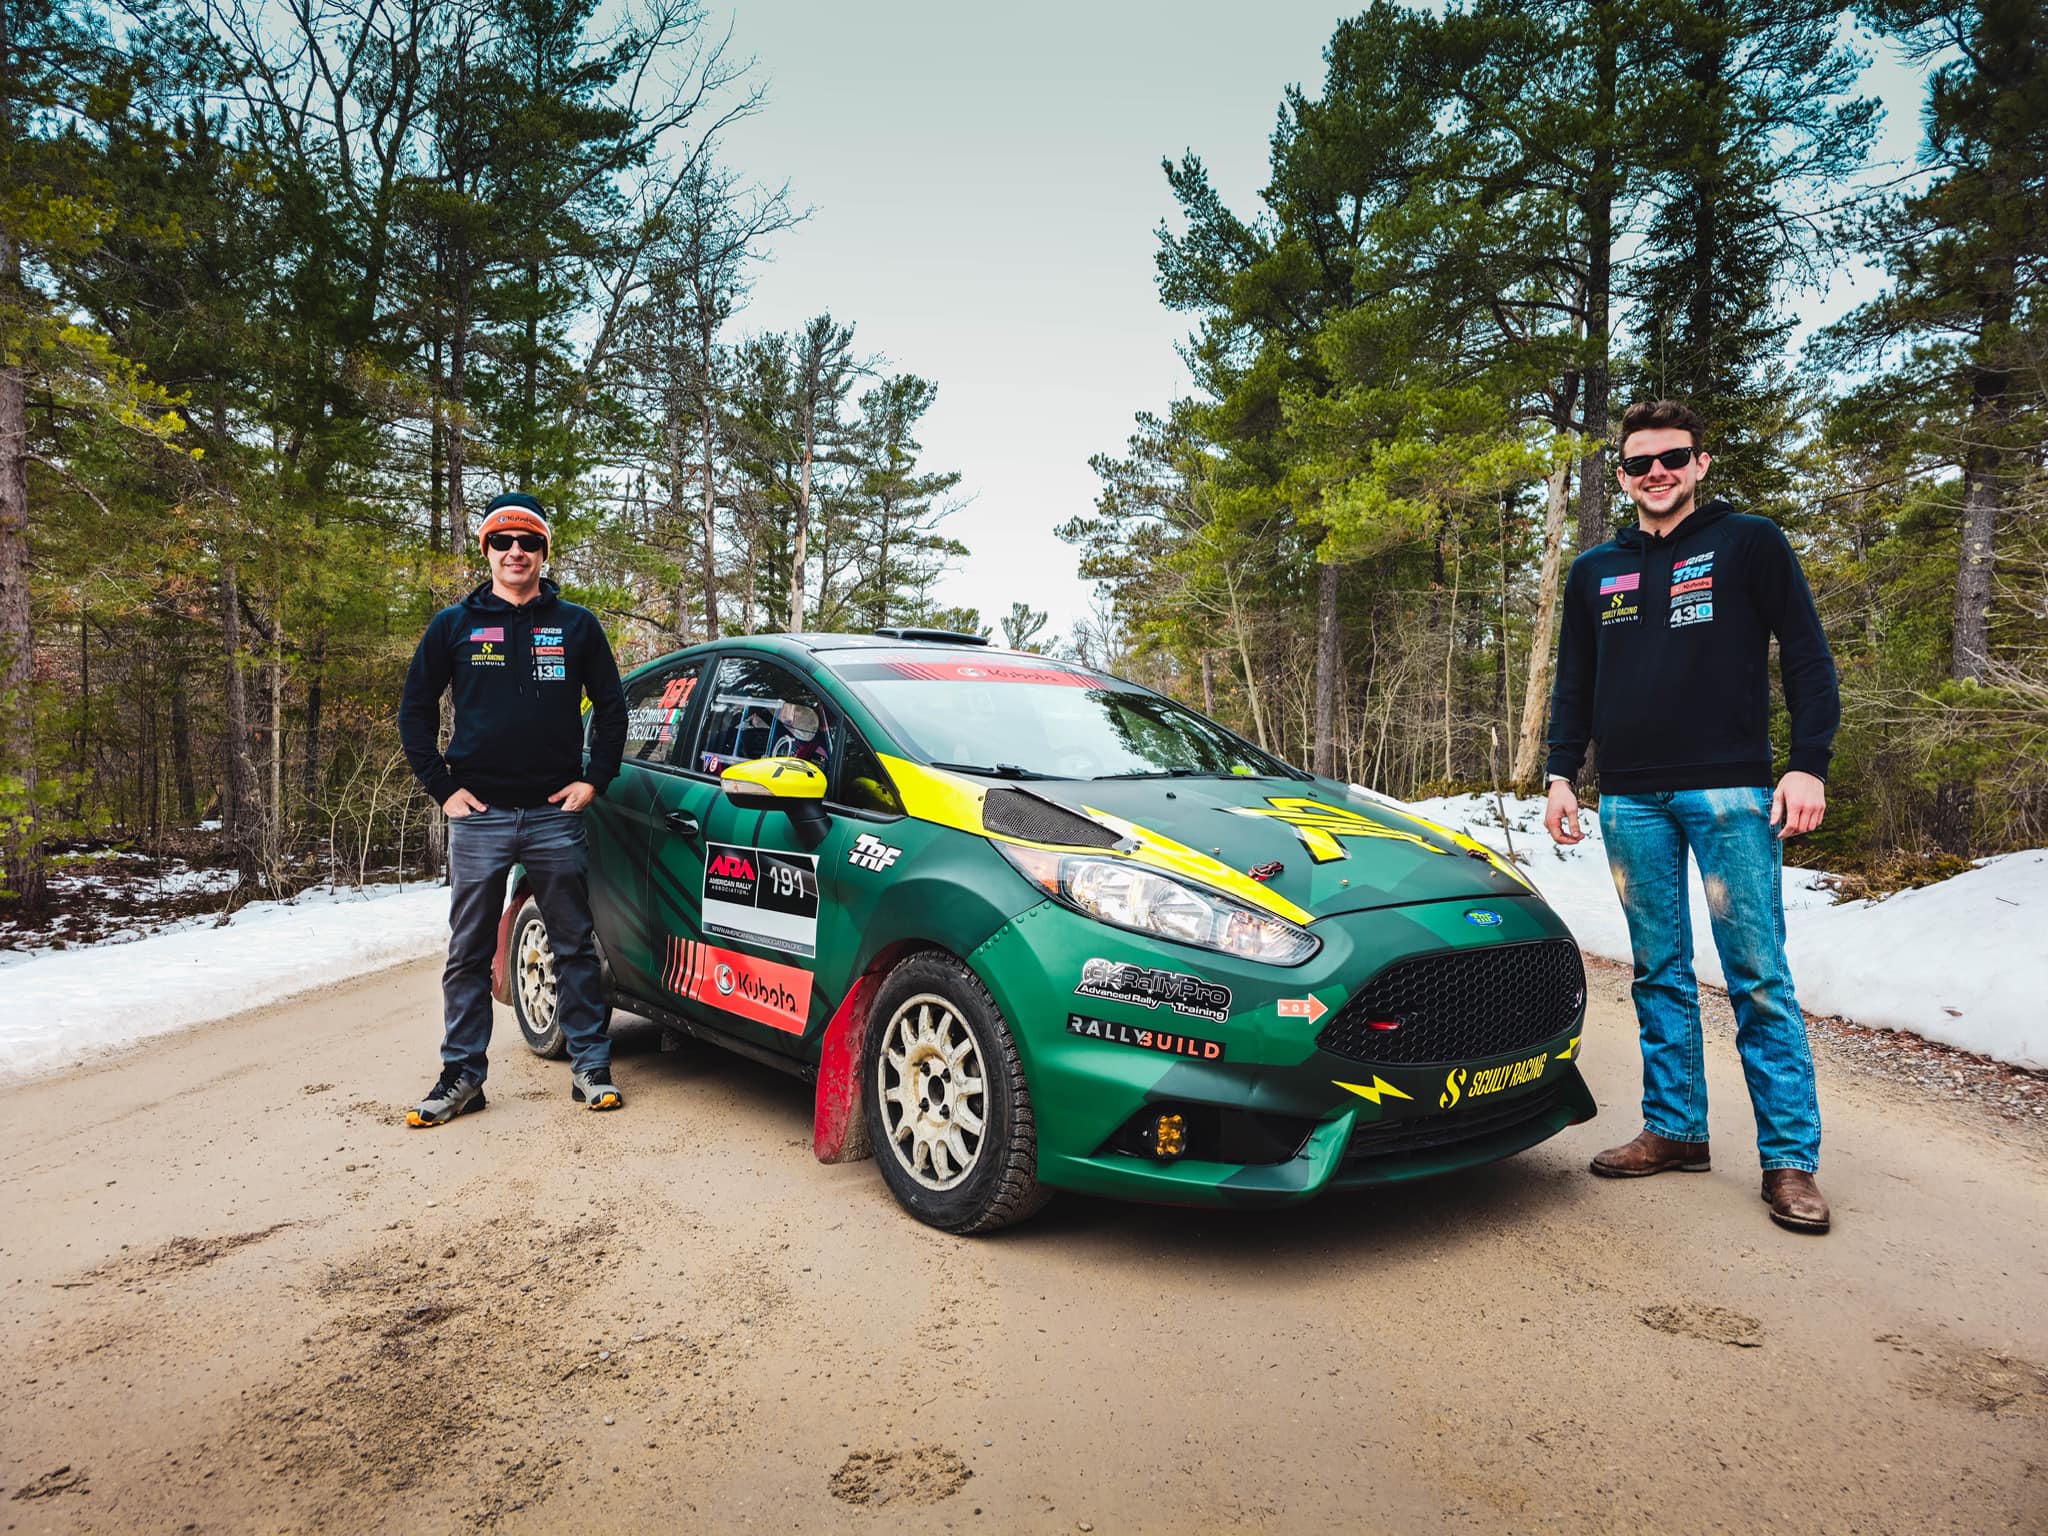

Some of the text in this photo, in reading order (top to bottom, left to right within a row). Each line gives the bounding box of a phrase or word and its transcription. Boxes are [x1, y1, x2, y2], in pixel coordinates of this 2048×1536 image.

[657, 677, 698, 709] 191
[708, 854, 756, 881] ARA
[848, 832, 902, 873] TRF
[708, 877, 752, 891] AMERICAN RALLY
[769, 866, 804, 899] 191
[738, 970, 796, 1013] Kubota
[1079, 984, 1158, 1007] Advanced Rally
[1175, 1002, 1225, 1021] Training
[1467, 1064, 1514, 1098] SCULLY
[1508, 1052, 1548, 1088] RACING
